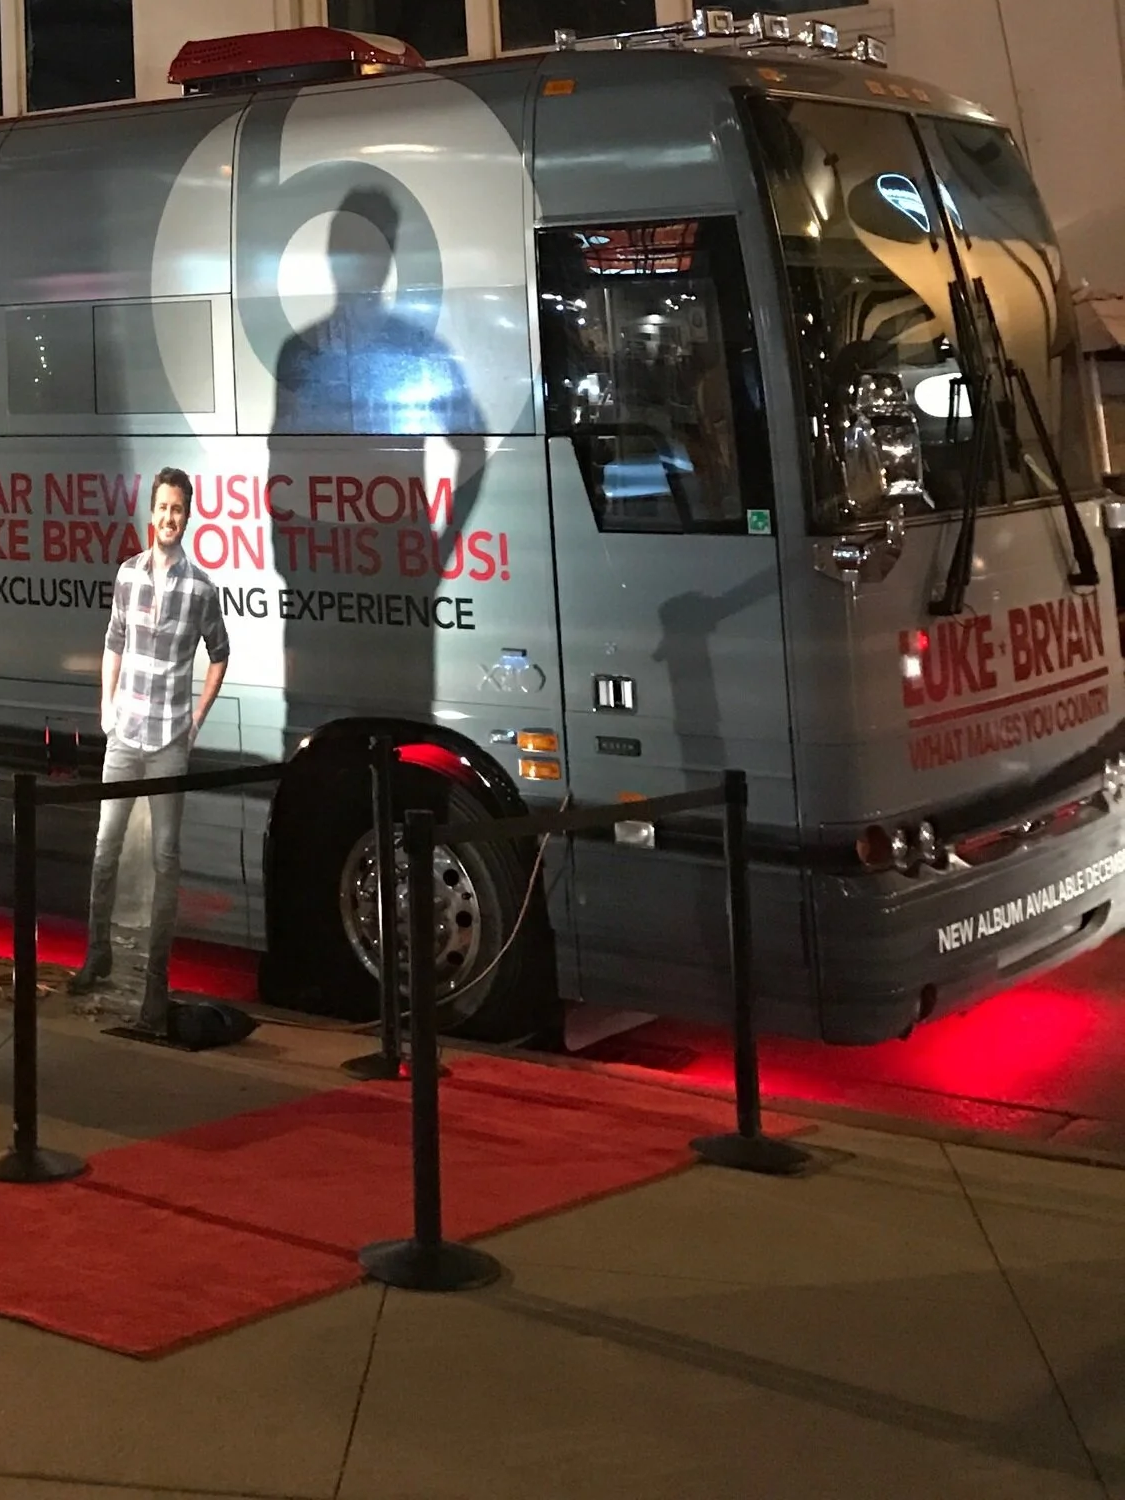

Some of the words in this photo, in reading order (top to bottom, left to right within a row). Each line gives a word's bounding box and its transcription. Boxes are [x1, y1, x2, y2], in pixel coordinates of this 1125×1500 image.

[45, 473, 141, 517] NEW
[154, 474, 294, 522] USIC
[308, 475, 454, 526] FROM
[193, 523, 265, 571] ON
[279, 525, 383, 577] THIS
[397, 529, 511, 582] BUS!
[278, 588, 476, 631] EXPERIENCE
[899, 613, 997, 709] LUKE
[1007, 590, 1105, 682] BRYAN
[907, 728, 963, 772] WHAT
[967, 713, 1022, 759] MAKES
[1025, 702, 1054, 742] YOU
[1055, 683, 1110, 732] COUNTRY
[938, 917, 974, 953] NEW
[977, 898, 1024, 939] ALBUM
[1026, 871, 1085, 920] AVAILABLE
